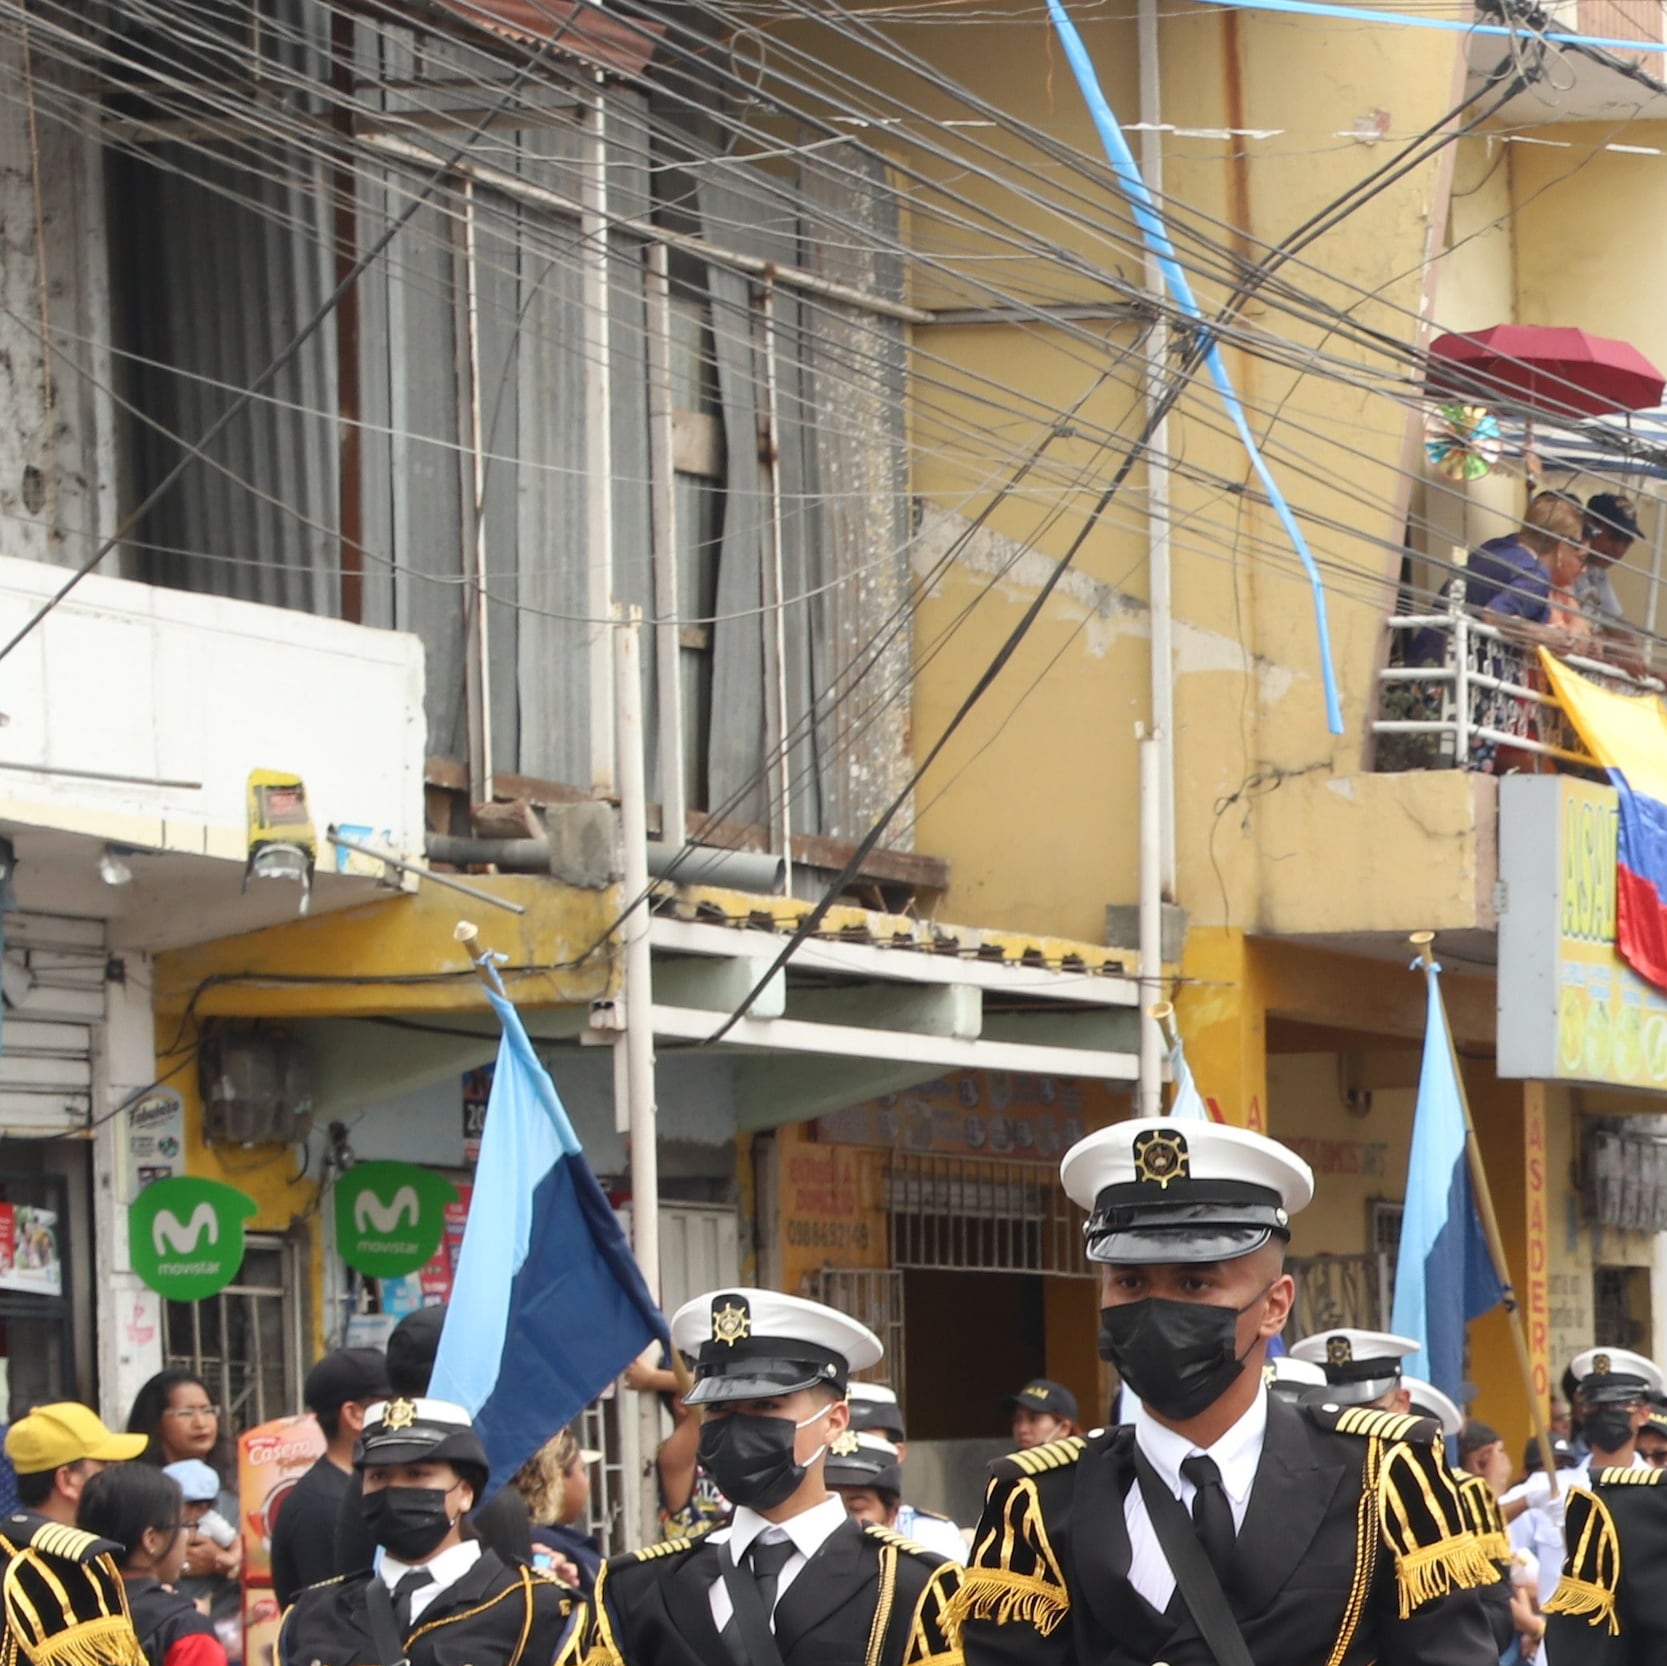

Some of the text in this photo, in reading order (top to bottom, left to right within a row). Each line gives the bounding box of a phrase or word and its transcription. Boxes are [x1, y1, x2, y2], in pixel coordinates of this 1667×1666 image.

[357, 1241, 419, 1255] movistar
[1527, 1116, 1549, 1397] ASADERO
[158, 1261, 221, 1276] movistar
[248, 1441, 311, 1467] Casero
